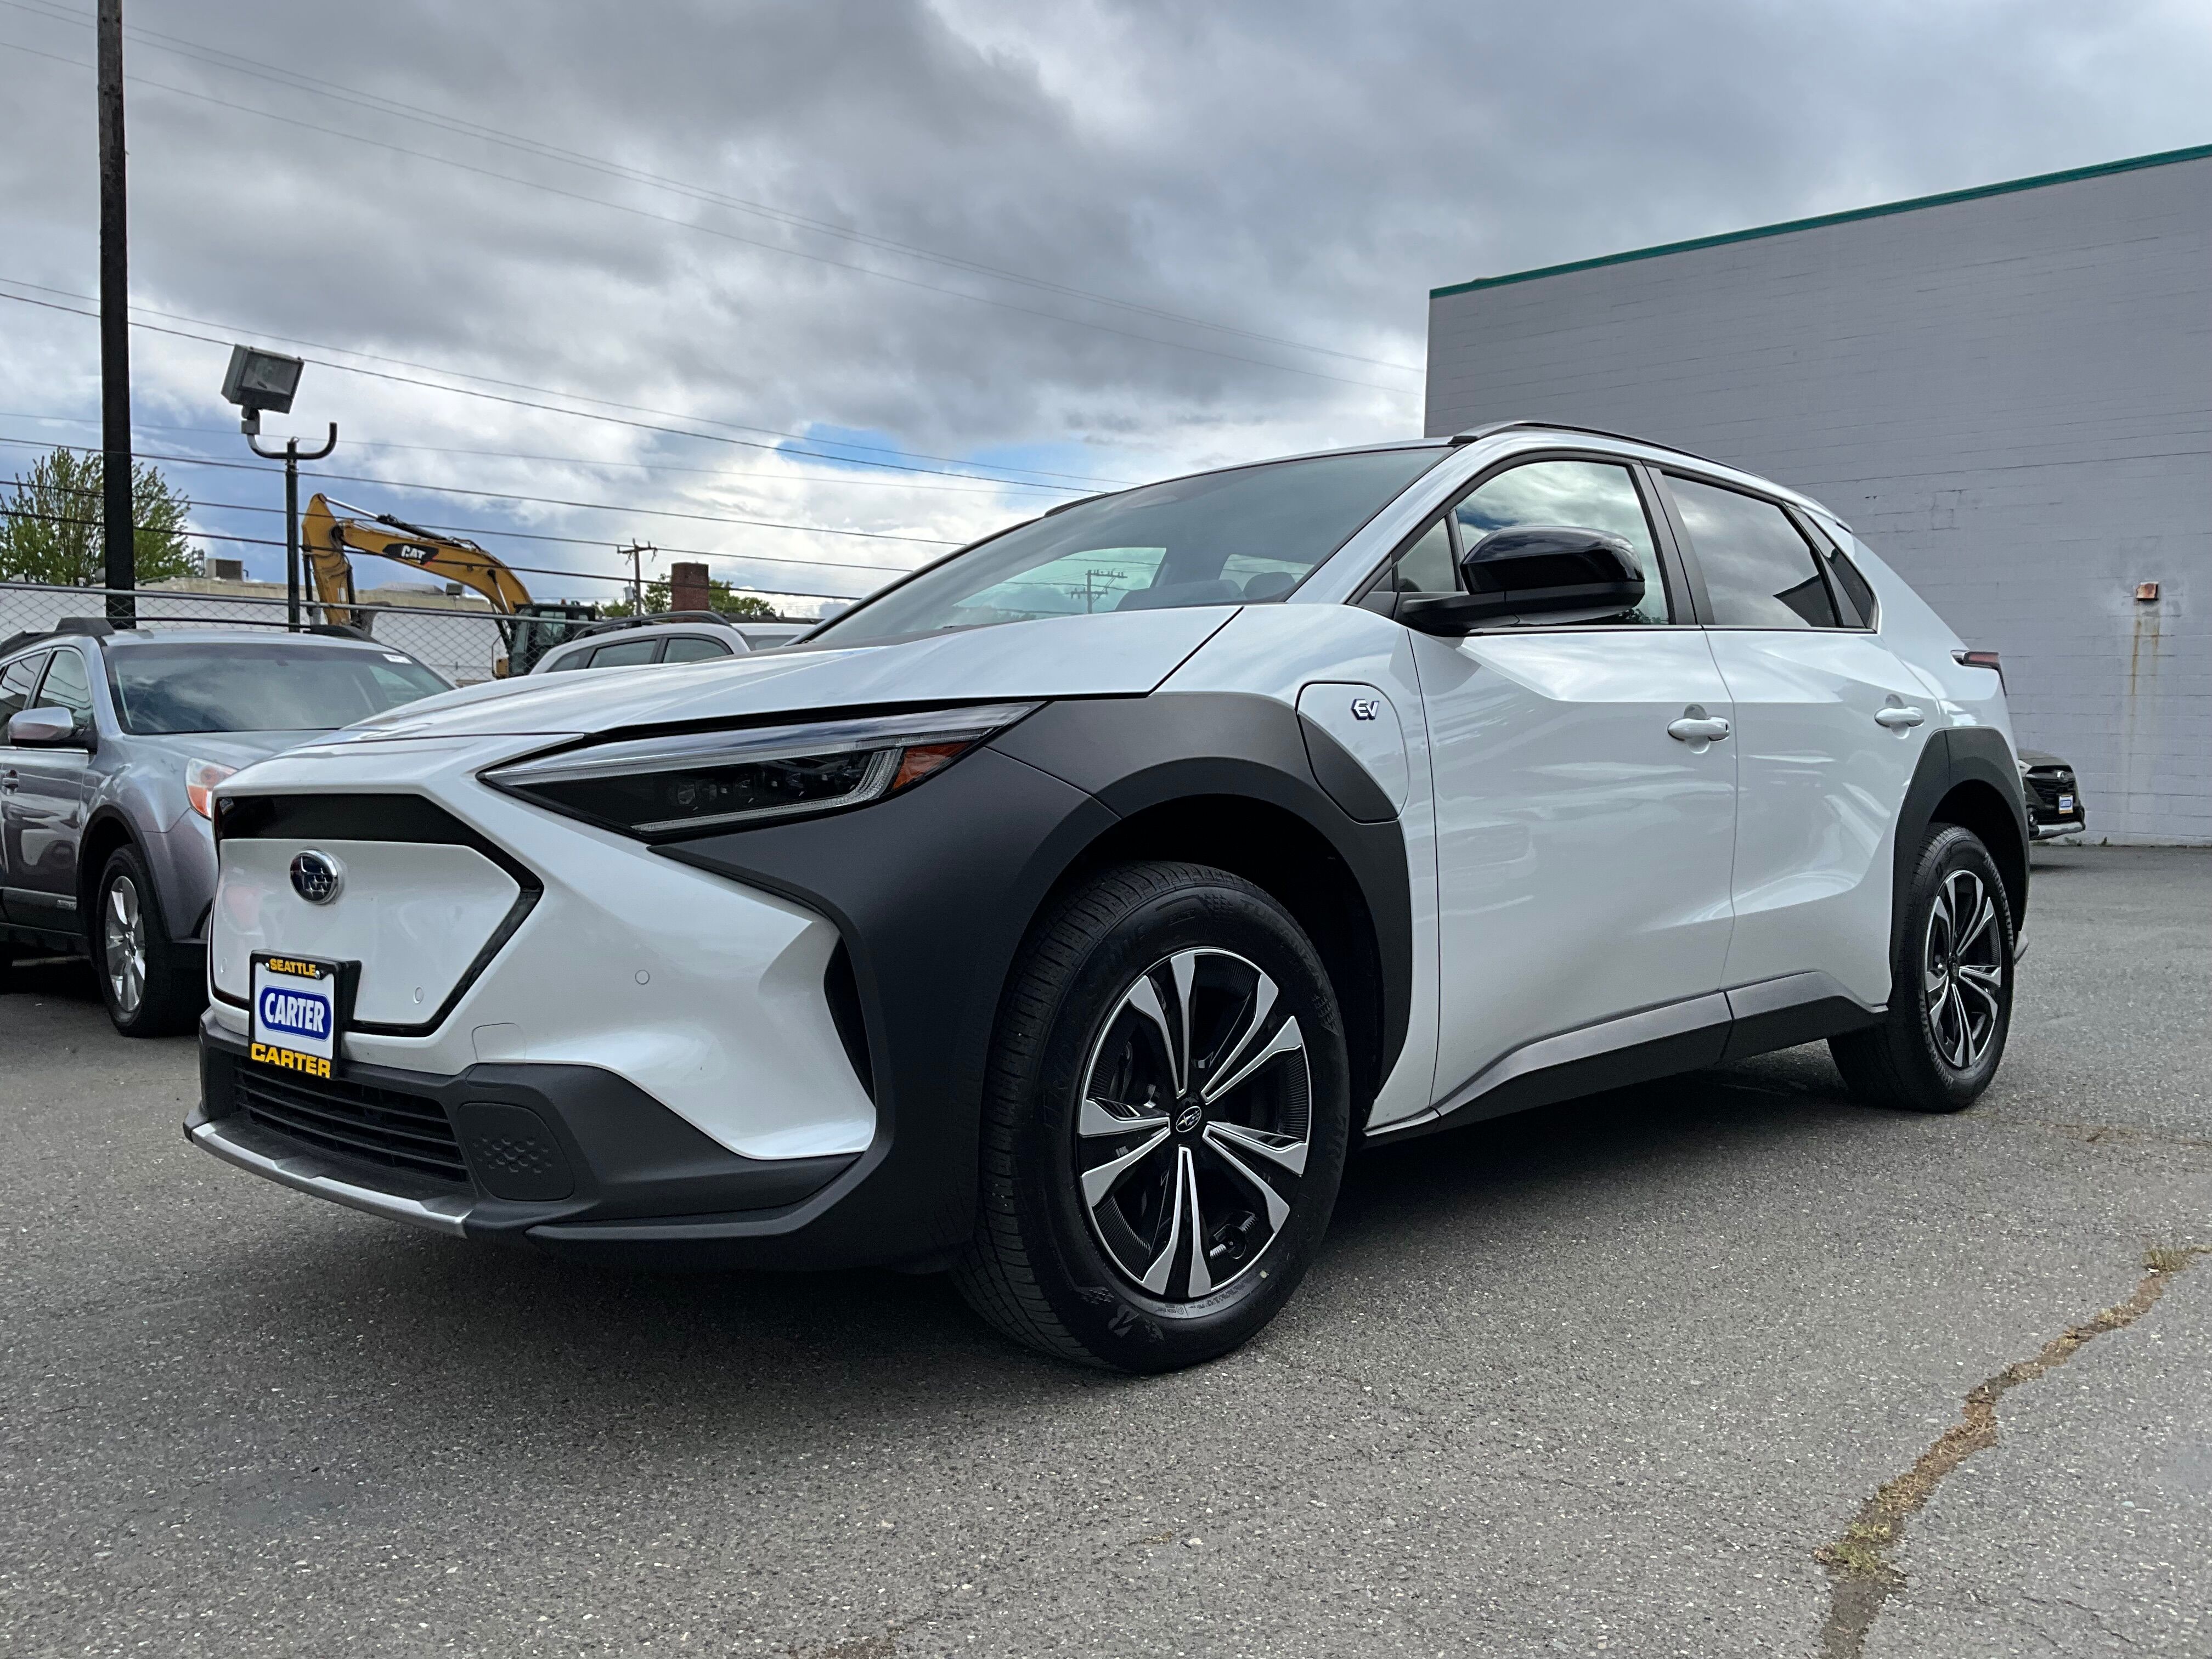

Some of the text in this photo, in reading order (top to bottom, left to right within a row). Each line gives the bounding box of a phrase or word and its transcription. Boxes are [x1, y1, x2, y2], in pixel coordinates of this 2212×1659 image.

[401, 545, 426, 562] CAT
[1351, 698, 1380, 720] EV
[269, 958, 317, 977] SEATTLE
[264, 992, 325, 1033] CARTER
[251, 1042, 331, 1079] CARTER
